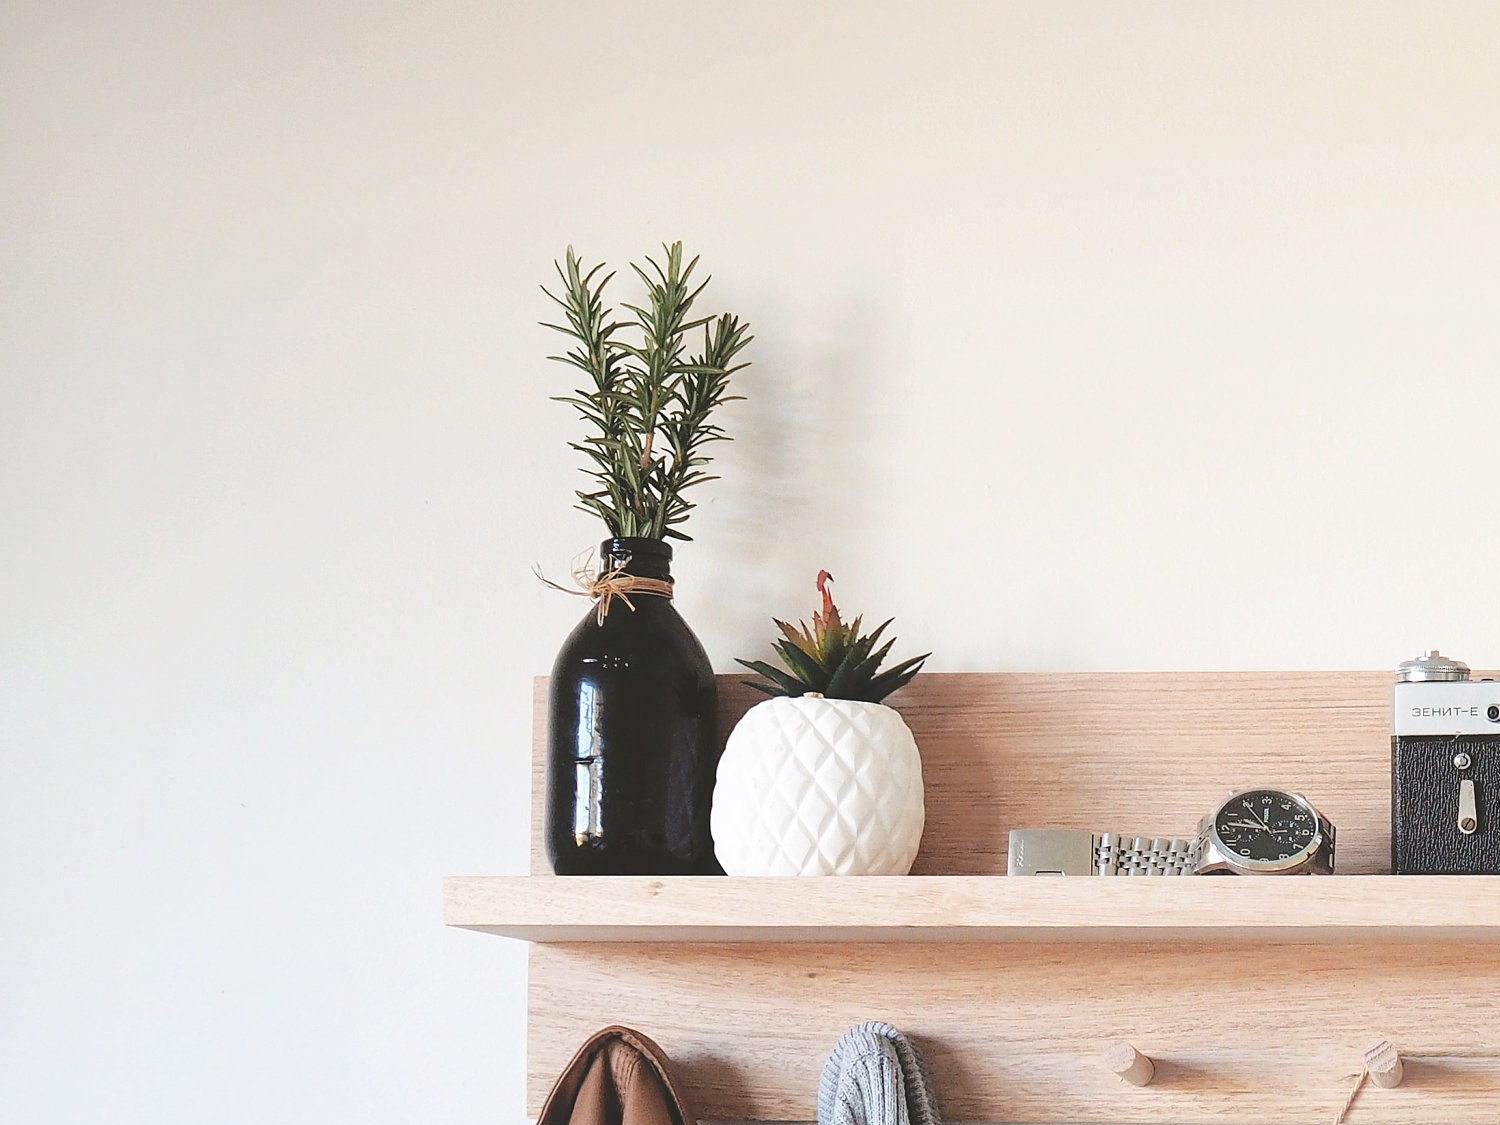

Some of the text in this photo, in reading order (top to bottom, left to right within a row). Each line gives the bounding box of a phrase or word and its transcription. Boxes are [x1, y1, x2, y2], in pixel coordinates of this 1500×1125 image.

[1411, 706, 1479, 717] ЗЕНИТ-Е
[1280, 803, 1292, 811] 4
[1221, 824, 1231, 834] 12
[1226, 839, 1237, 847] 11
